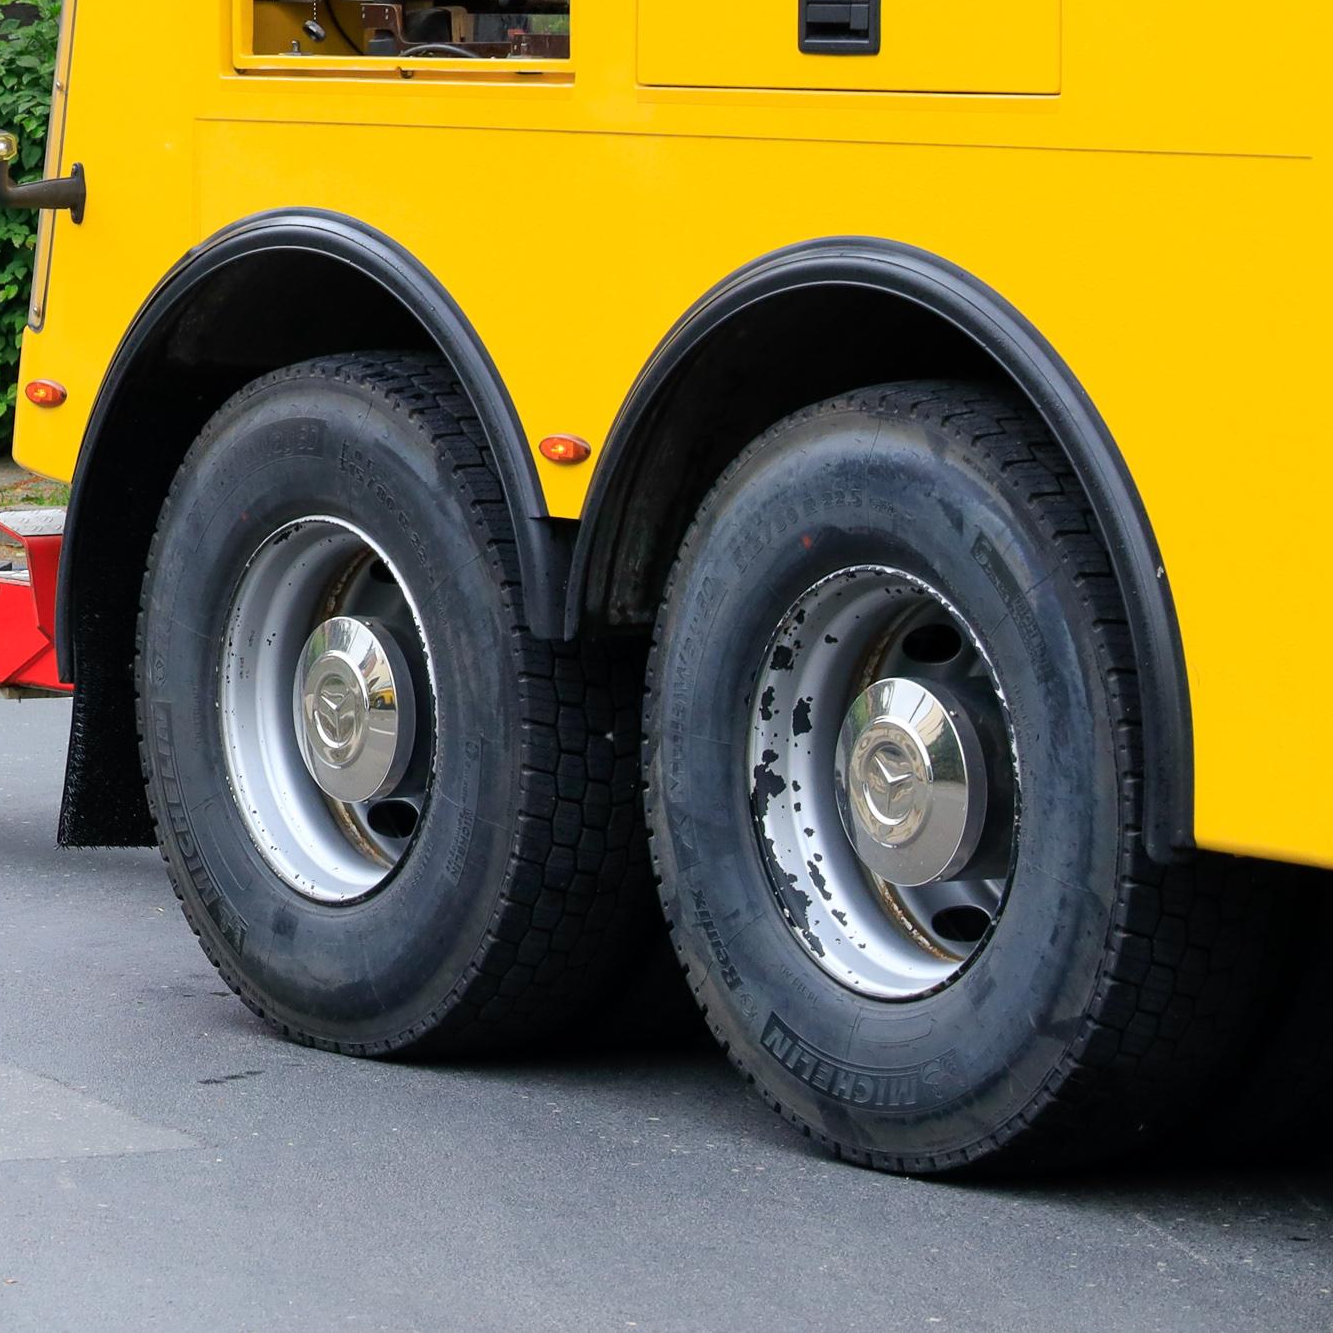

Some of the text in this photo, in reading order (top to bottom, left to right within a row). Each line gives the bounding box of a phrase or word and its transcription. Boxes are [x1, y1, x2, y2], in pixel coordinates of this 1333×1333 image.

[154, 708, 220, 907] MICHELIN
[690, 888, 745, 992] Remix
[762, 1025, 918, 1106] MICHELIN
